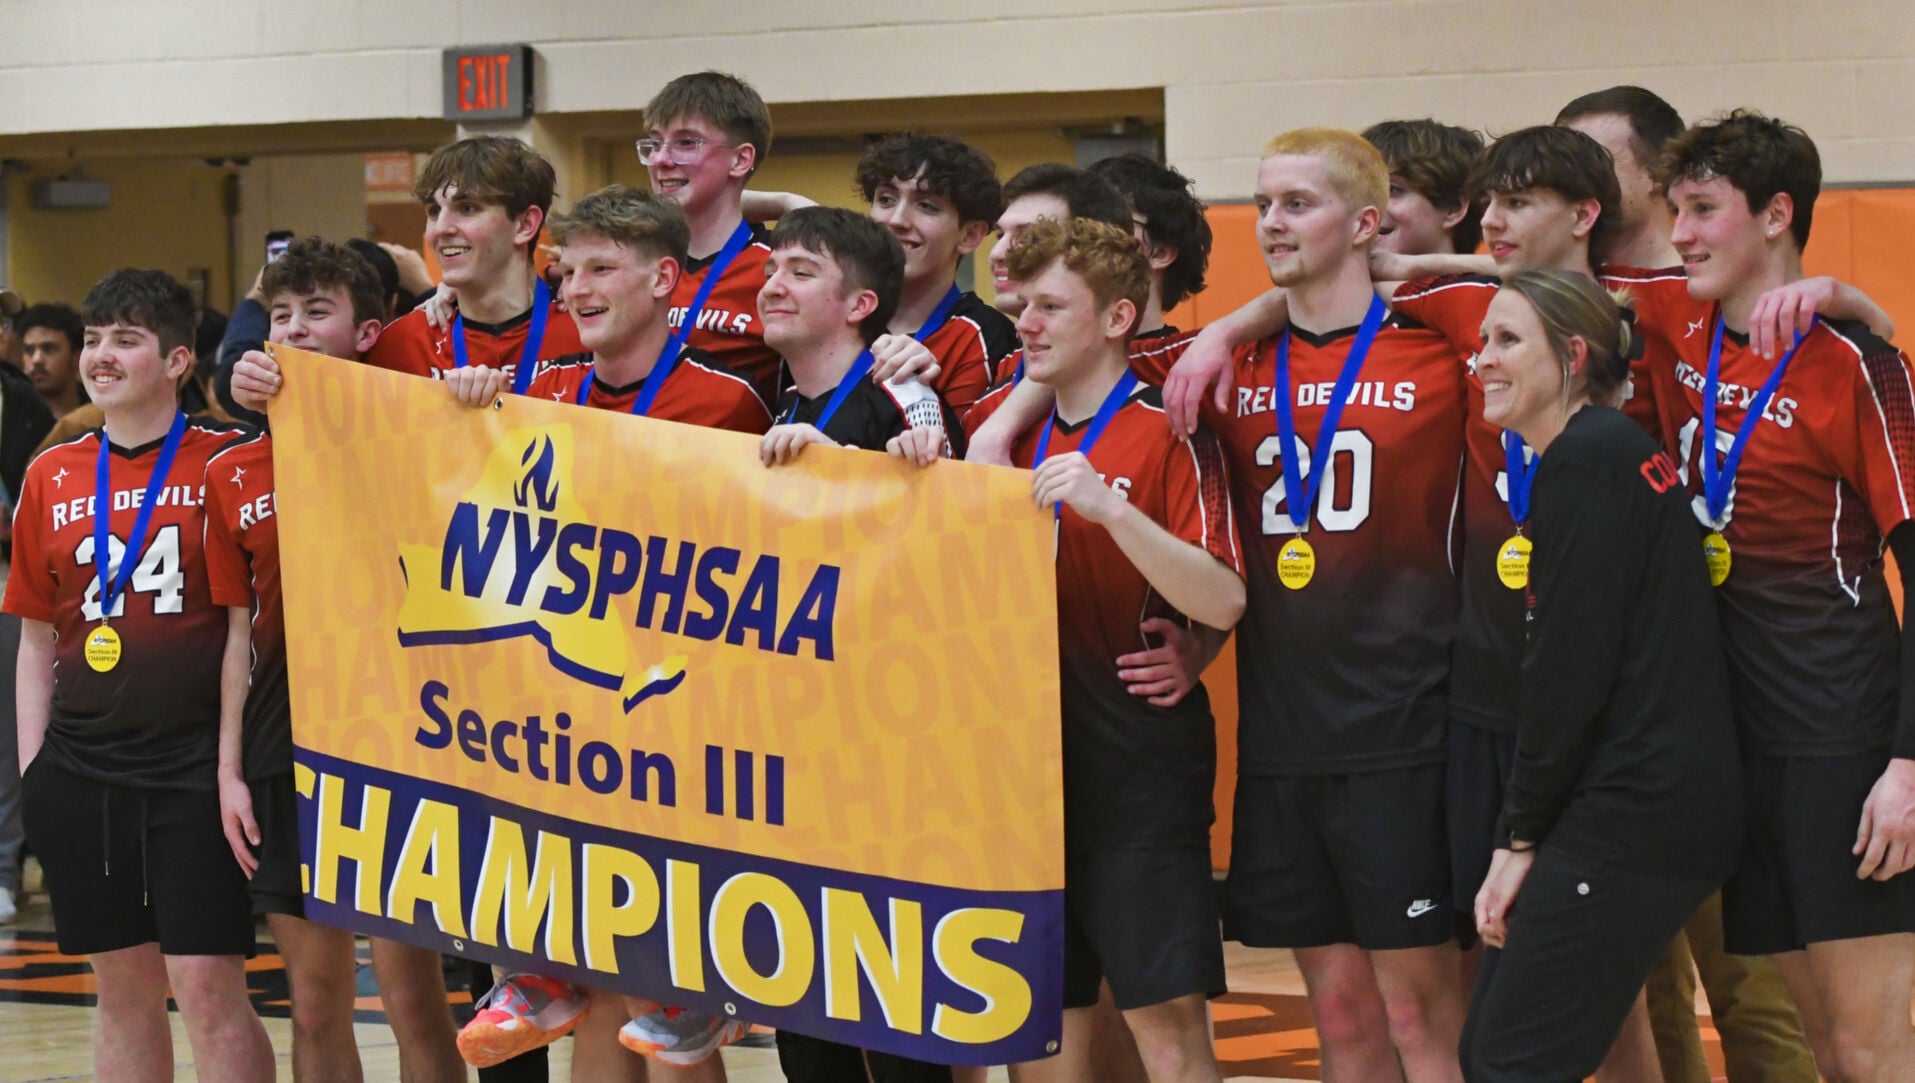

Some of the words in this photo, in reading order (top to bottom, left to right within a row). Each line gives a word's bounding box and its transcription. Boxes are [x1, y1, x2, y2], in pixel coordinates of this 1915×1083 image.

[457, 54, 510, 110] EXIT
[238, 492, 277, 531] RE
[1255, 429, 1373, 535] 20
[1640, 451, 1680, 494] CO
[74, 524, 184, 622] 24
[441, 500, 841, 662] NYSPHSAA
[414, 679, 676, 808] Section
[705, 744, 785, 826] III
